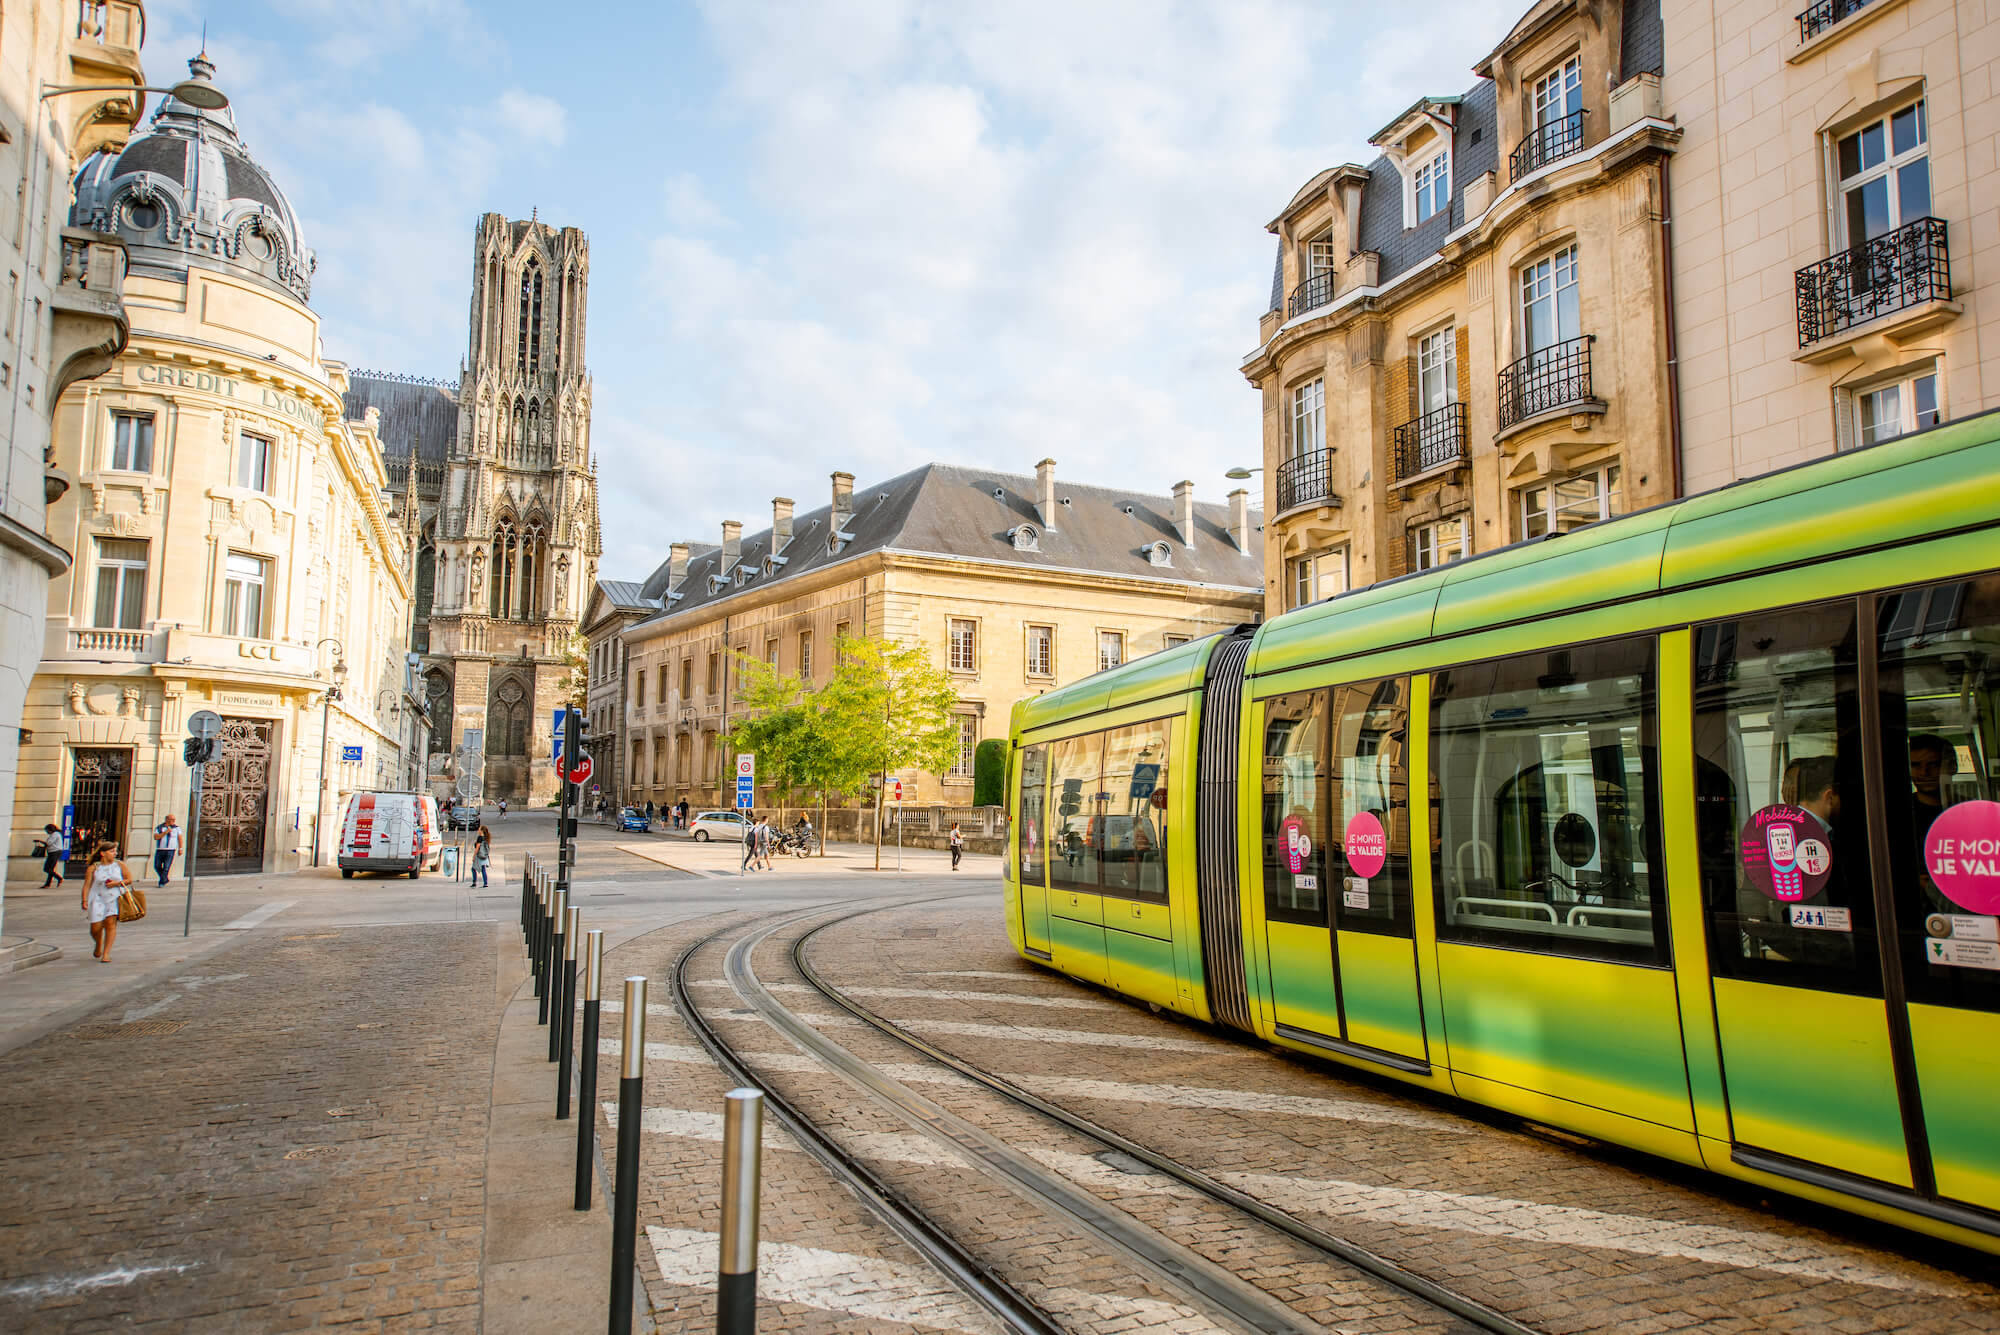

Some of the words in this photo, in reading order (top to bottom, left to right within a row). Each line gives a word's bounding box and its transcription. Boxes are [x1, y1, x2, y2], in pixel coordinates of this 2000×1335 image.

[137, 363, 239, 397] CREDIT
[239, 643, 281, 662] LCL
[1348, 834, 1355, 844] JE
[1357, 834, 1382, 844] MONTE
[1933, 839, 1955, 854] JE
[1348, 846, 1355, 855] JE
[1357, 846, 1383, 856] VALIDE
[1806, 845, 1818, 856] 1H
[1933, 858, 1957, 875] JE
